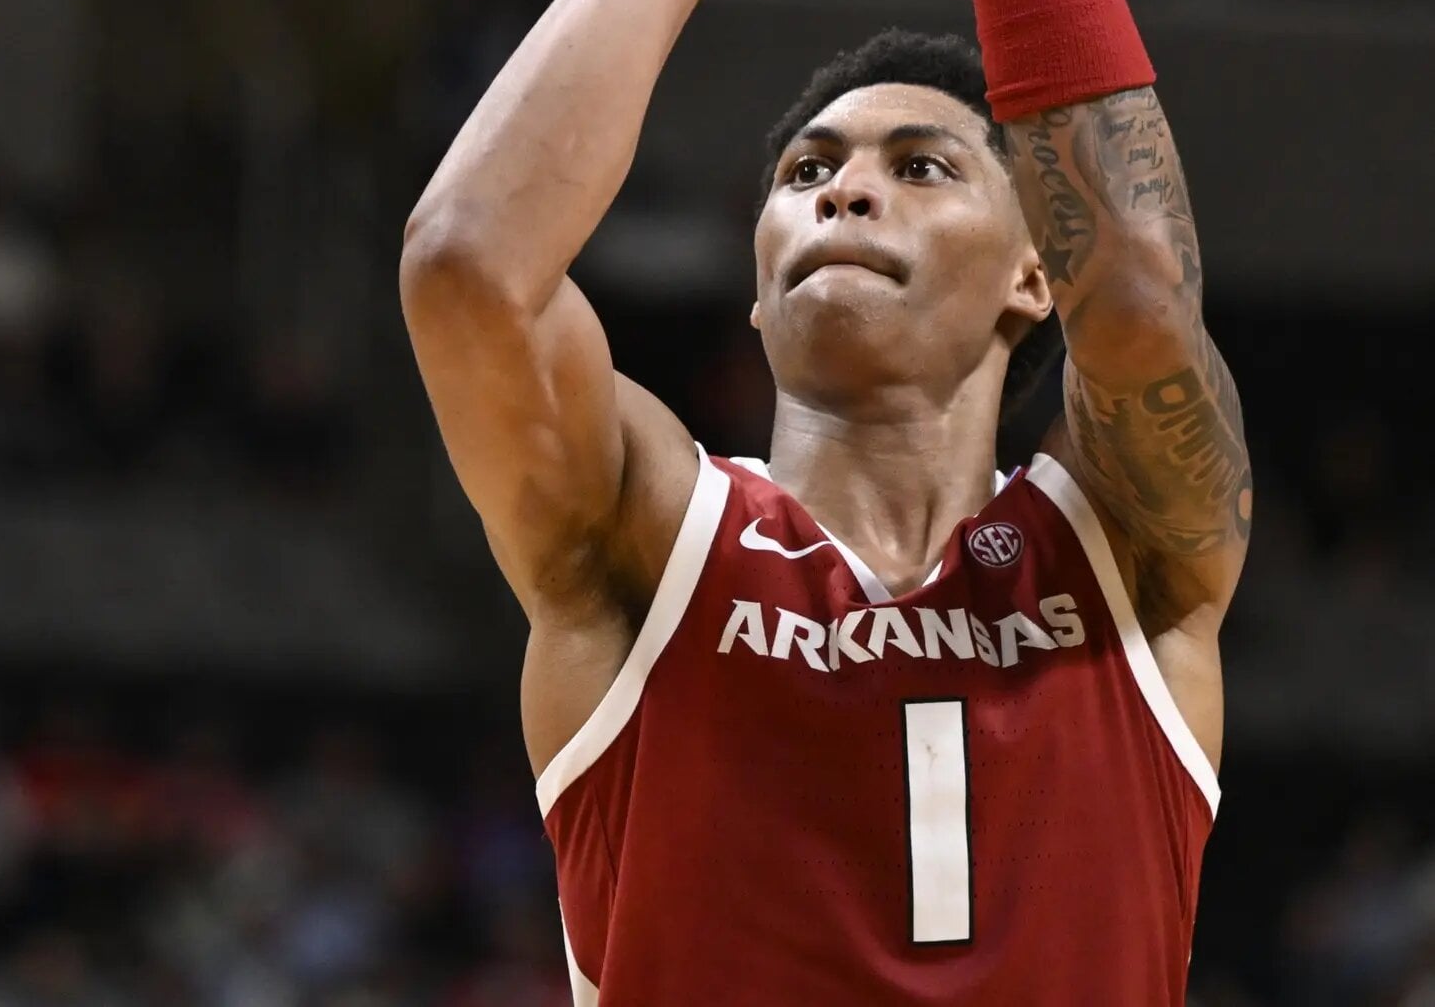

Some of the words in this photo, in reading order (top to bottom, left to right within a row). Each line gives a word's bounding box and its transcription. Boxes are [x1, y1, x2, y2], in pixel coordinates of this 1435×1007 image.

[973, 525, 1019, 563] SEC
[717, 594, 1085, 672] ARKANSAS
[902, 697, 973, 946] 1
